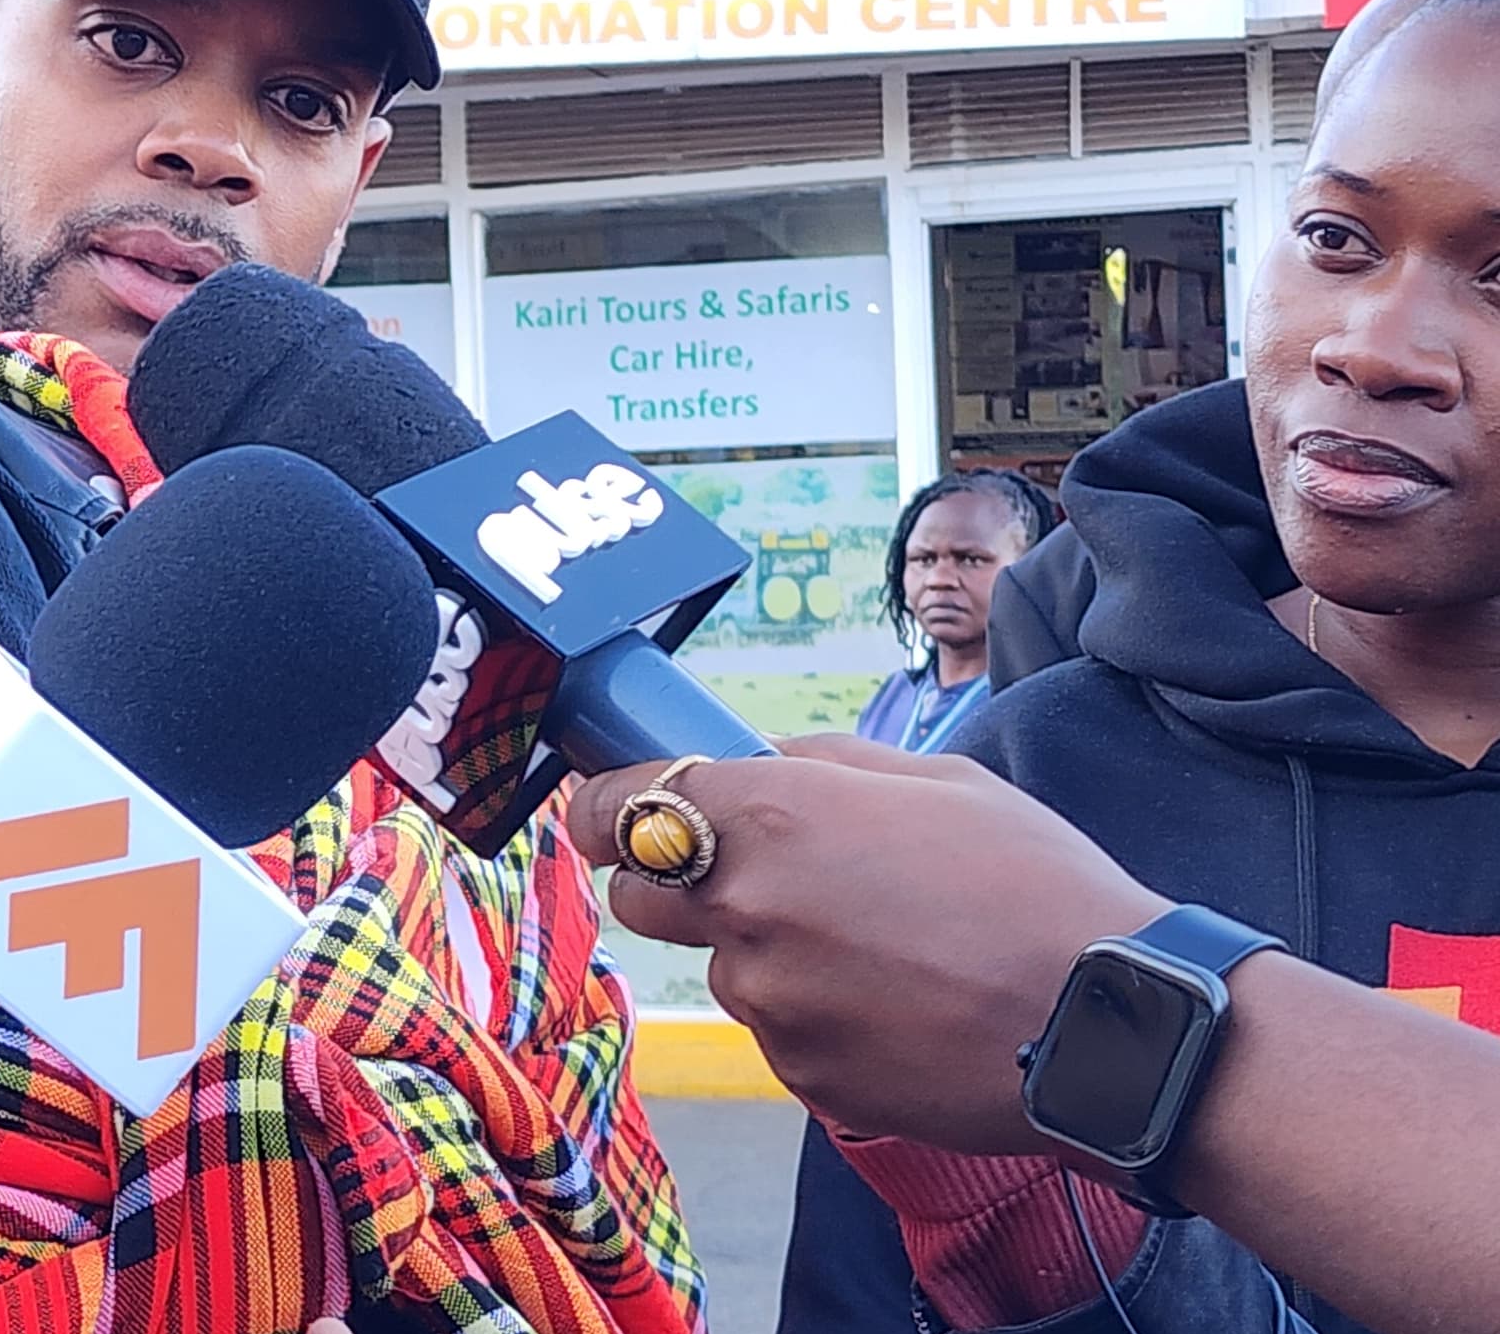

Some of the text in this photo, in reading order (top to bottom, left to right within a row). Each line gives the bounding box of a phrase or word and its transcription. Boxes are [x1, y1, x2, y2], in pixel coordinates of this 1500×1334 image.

[514, 283, 851, 328] Kairi Tours & Safaris
[609, 338, 754, 373] Car Hire,
[606, 388, 759, 422] Transfers
